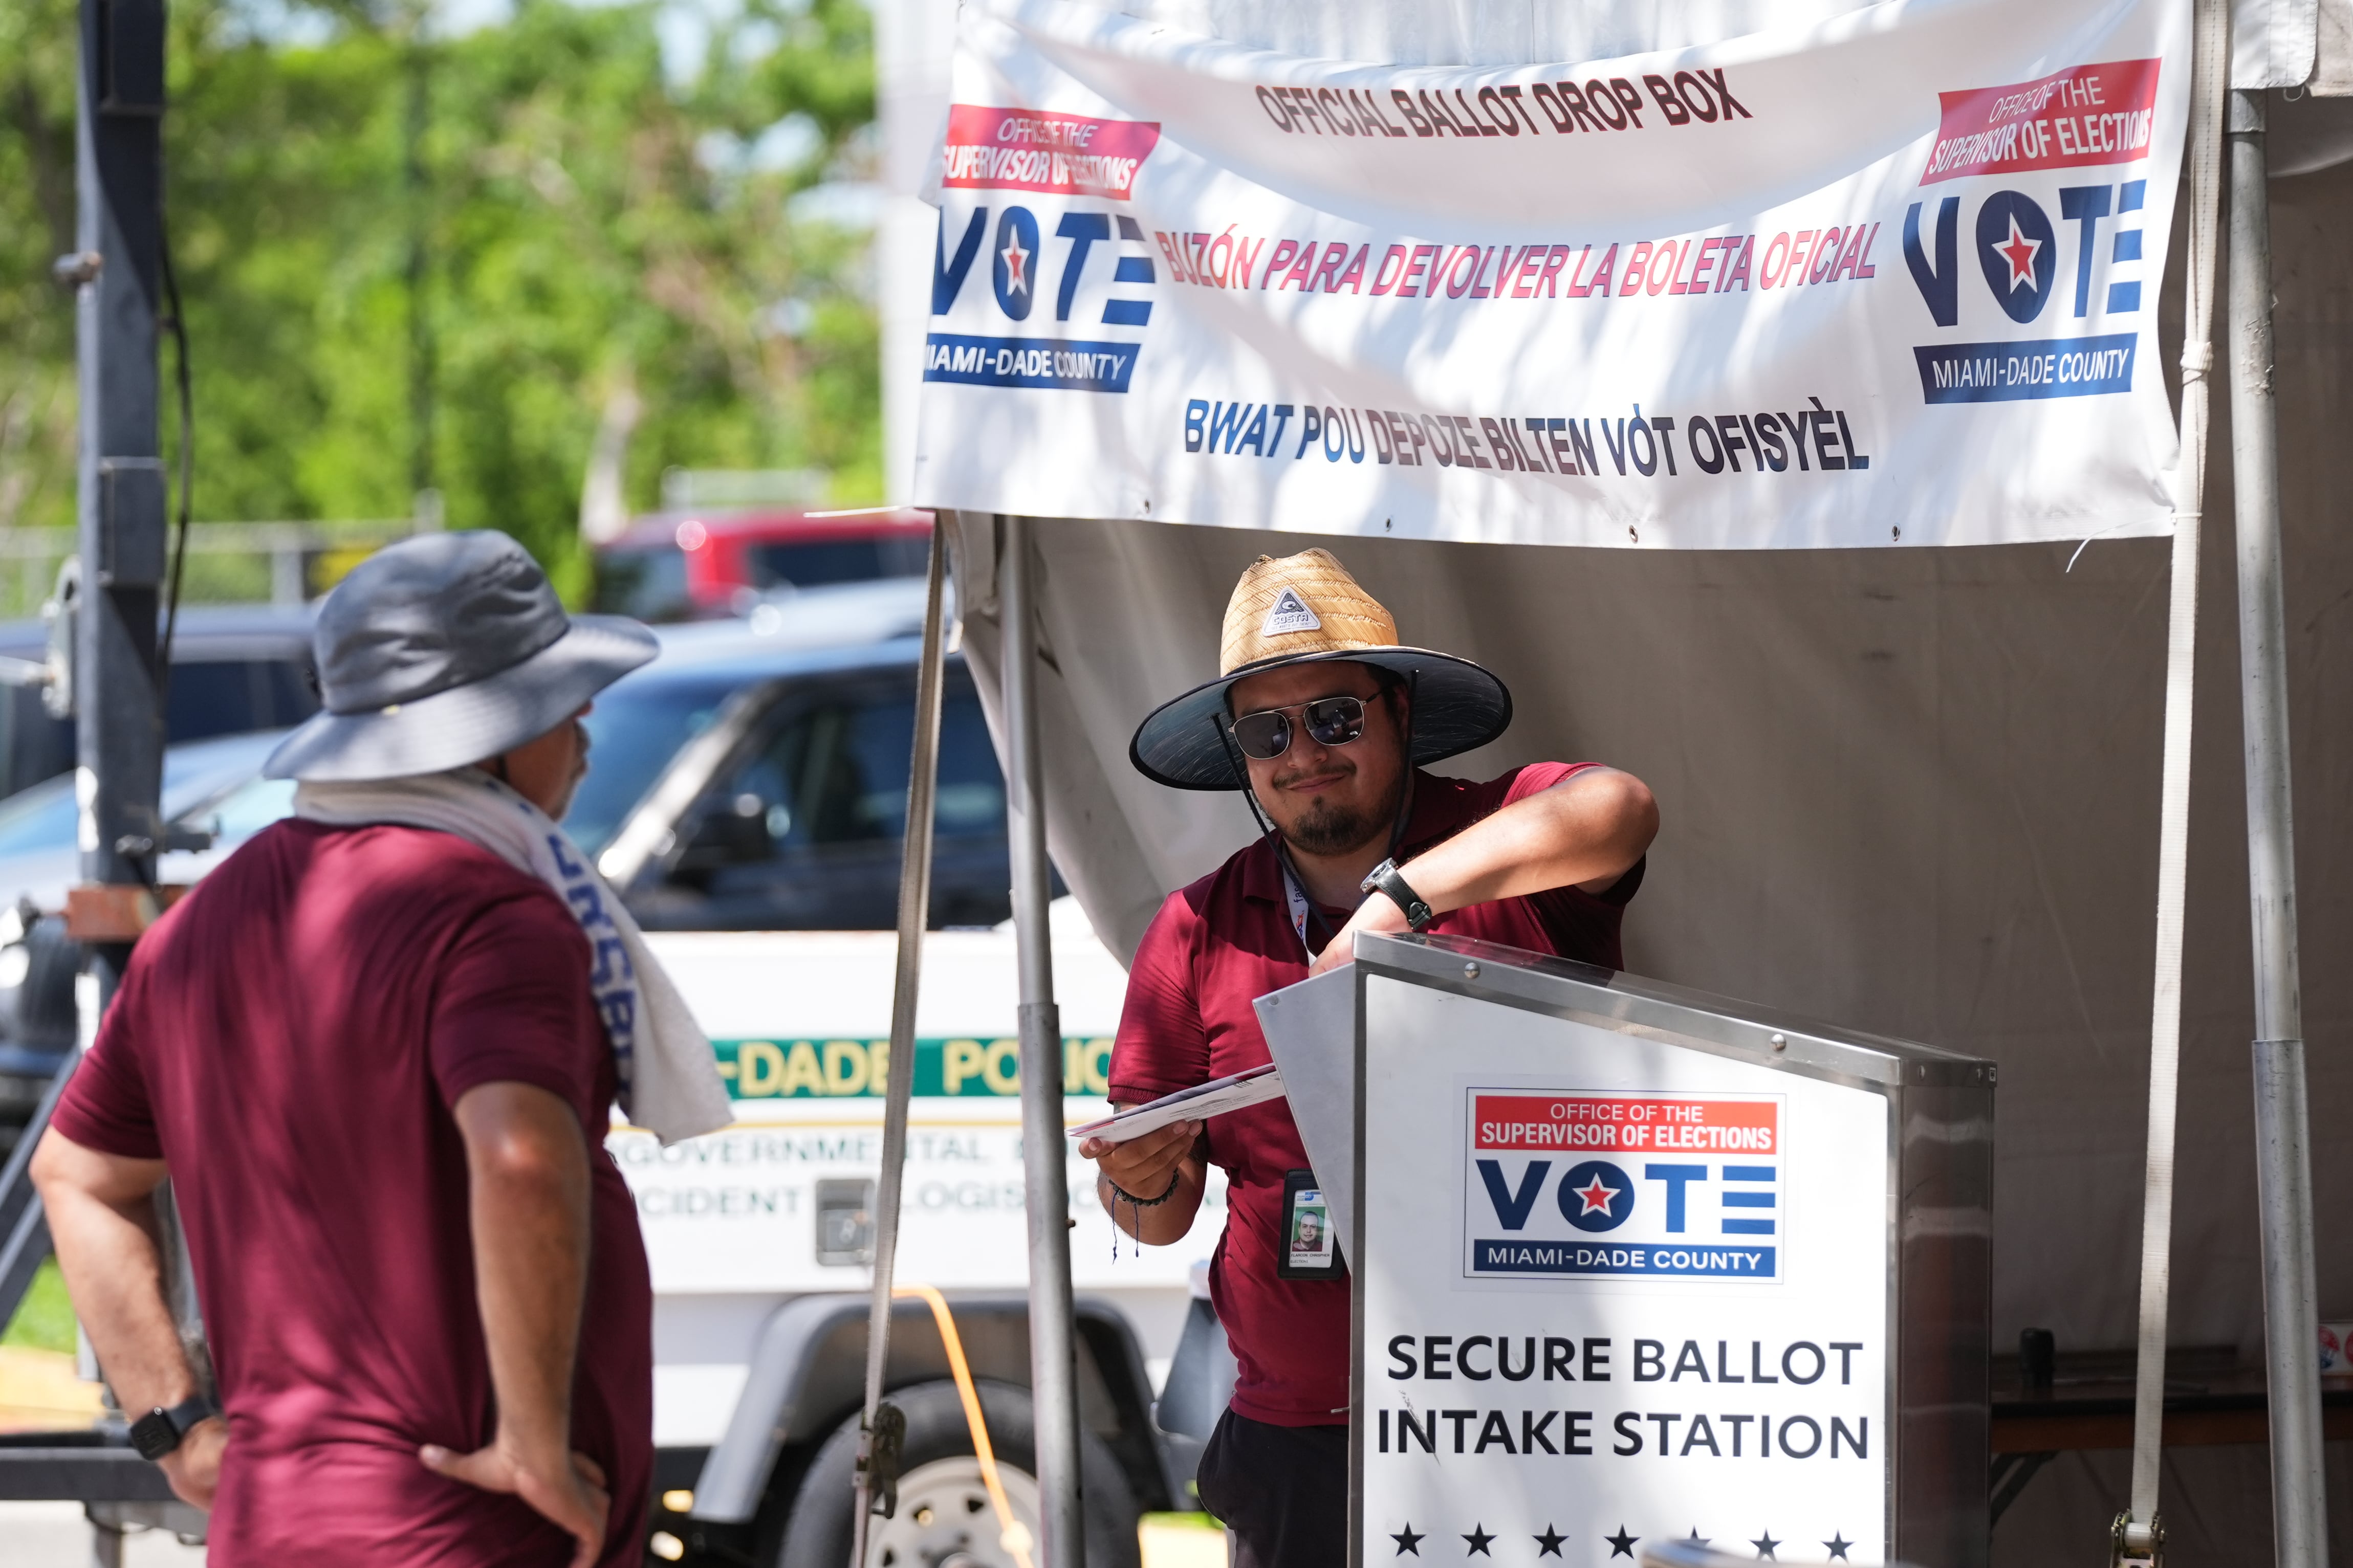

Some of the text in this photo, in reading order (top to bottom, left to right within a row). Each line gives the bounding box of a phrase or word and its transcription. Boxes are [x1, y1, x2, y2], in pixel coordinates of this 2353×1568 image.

[1256, 68, 1753, 137] OFFICIAL BALLOT DROP BOX
[1989, 76, 2105, 123] OFFICE OF THE
[1062, 121, 1099, 147] THE
[1928, 106, 2151, 175] SUPERVISOR OF ELECTIONS
[1052, 151, 1071, 185] OF
[932, 206, 1156, 326] VOTE
[1154, 222, 1881, 299] BUZÓN PARA DEVOLVER LA BOLETA OFICIAL
[1903, 179, 2147, 327] VOTE
[1054, 350, 1127, 381] COUNTY
[1932, 347, 2129, 388] MIAMI-DADE COUNTY
[1185, 396, 1869, 476] BWAT POU DEPOZE BILTEN VÒT OFISYÈL
[1273, 613, 1309, 625] COSTA
[717, 1039, 1115, 1097] -DADE POIC
[1481, 1122, 1772, 1150] SUPERVISOR OF ELECTIONS
[1550, 1103, 1704, 1122] OFFICE OF THE
[624, 1132, 991, 1164] GOVERNMETAL
[641, 1187, 802, 1216] CIDENT
[1475, 1159, 1776, 1235] VOTE
[1488, 1247, 1761, 1270] MIAMI-DADE COUNTY
[1387, 1334, 1864, 1385] SECURE BALLOT
[1378, 1409, 1868, 1460] INTAKE STATION
